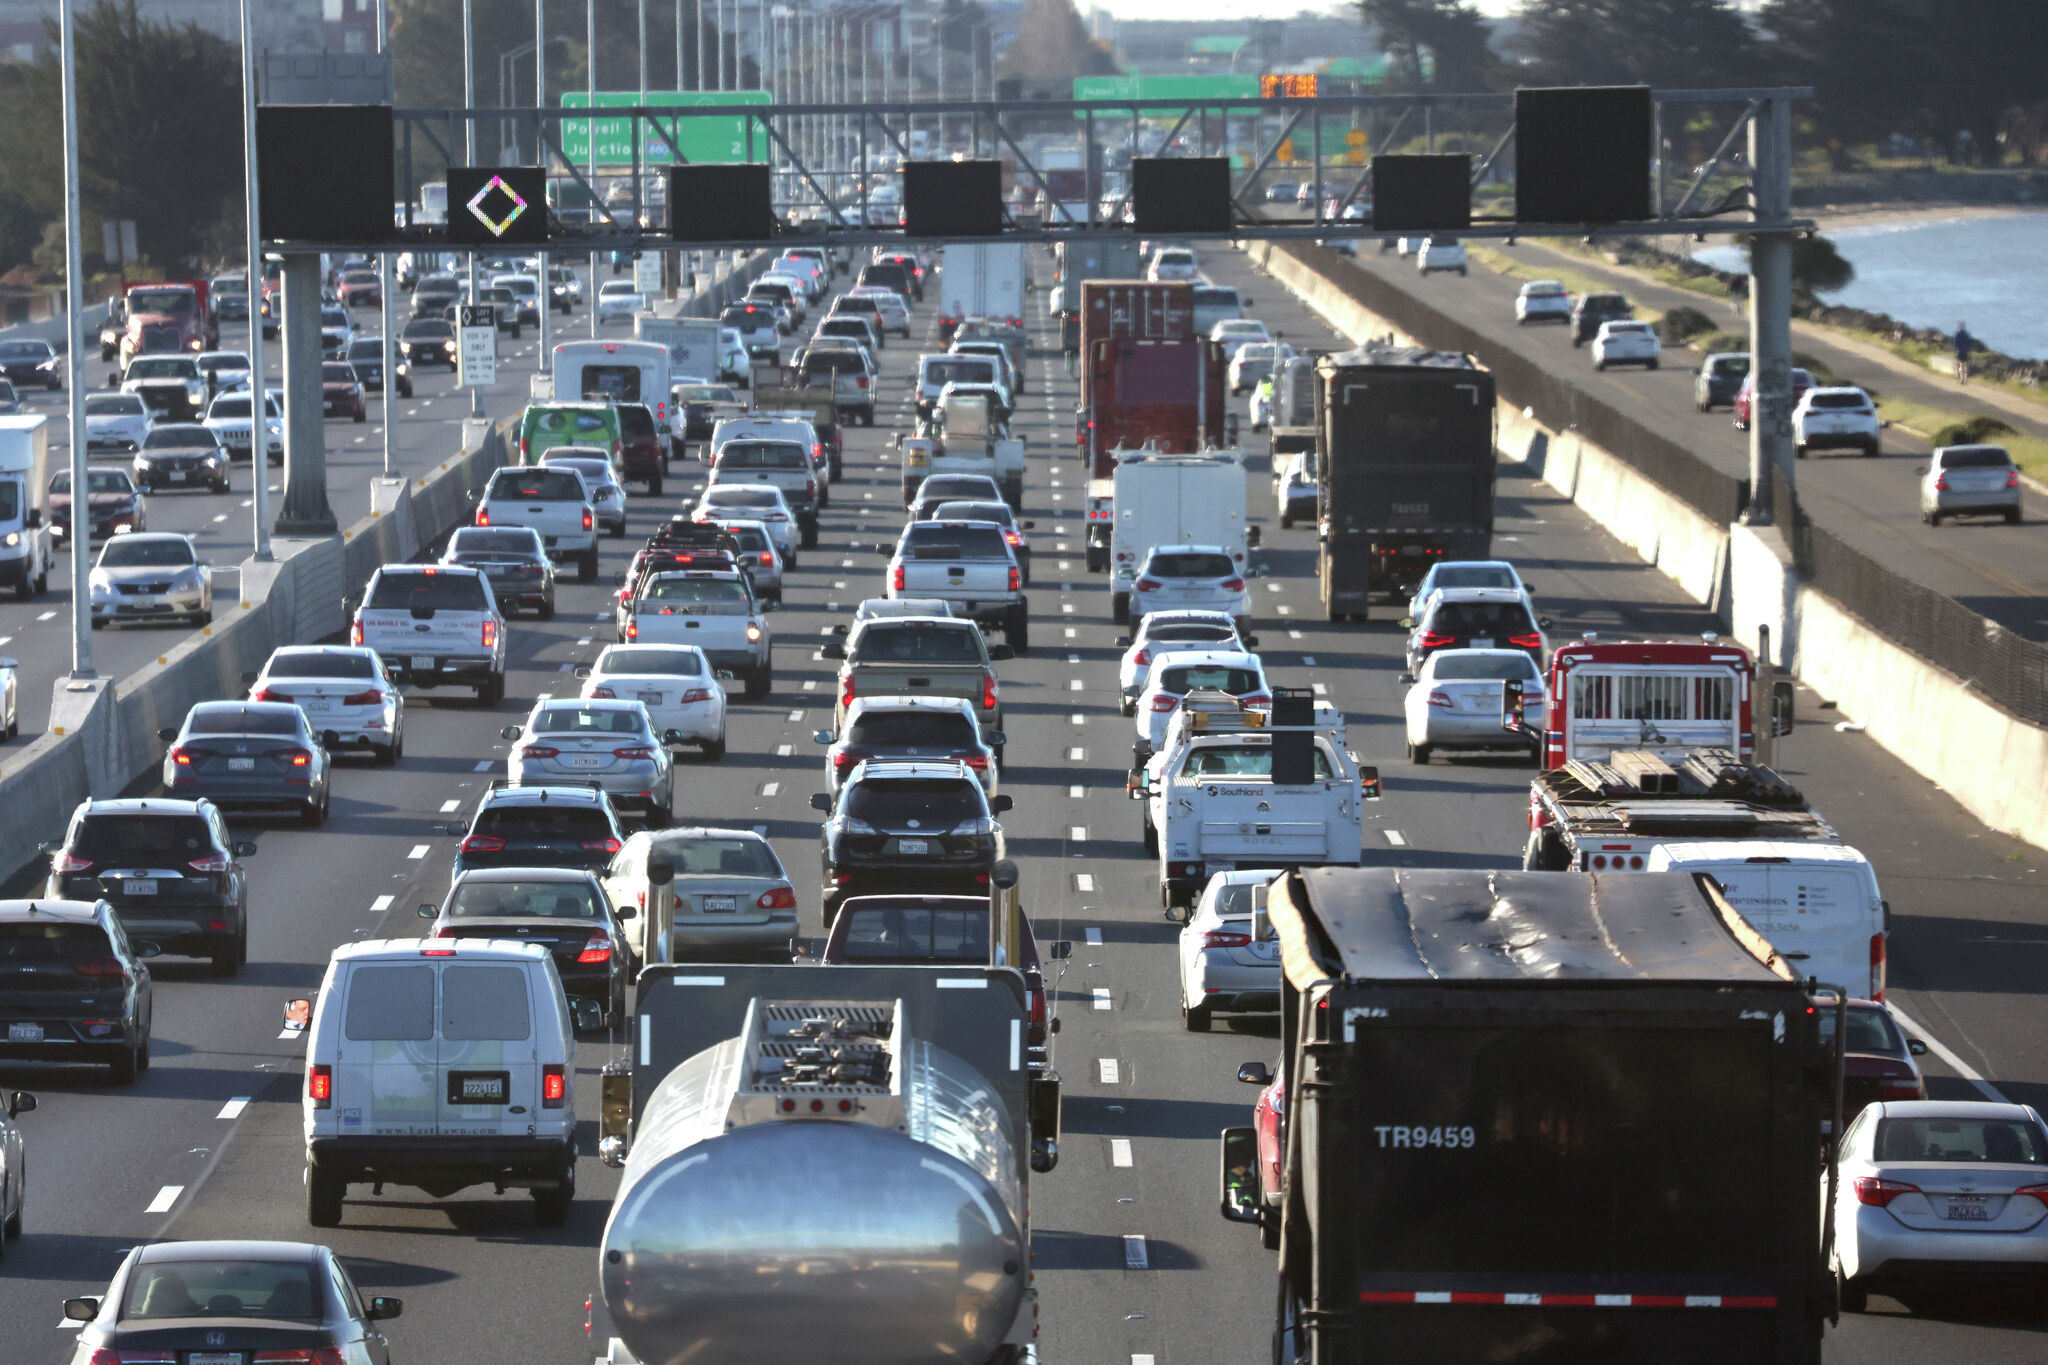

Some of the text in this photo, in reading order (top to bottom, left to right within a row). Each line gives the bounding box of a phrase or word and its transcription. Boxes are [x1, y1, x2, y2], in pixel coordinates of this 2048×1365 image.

[731, 142, 742, 153] 2
[1220, 785, 1264, 797] Southland
[1242, 837, 1284, 845] ROYAL
[464, 1083, 501, 1095] 32241E1
[375, 1125, 498, 1136] www.EastLawn.com
[527, 1124, 535, 1136] 5
[1374, 1124, 1476, 1149] TR9459
